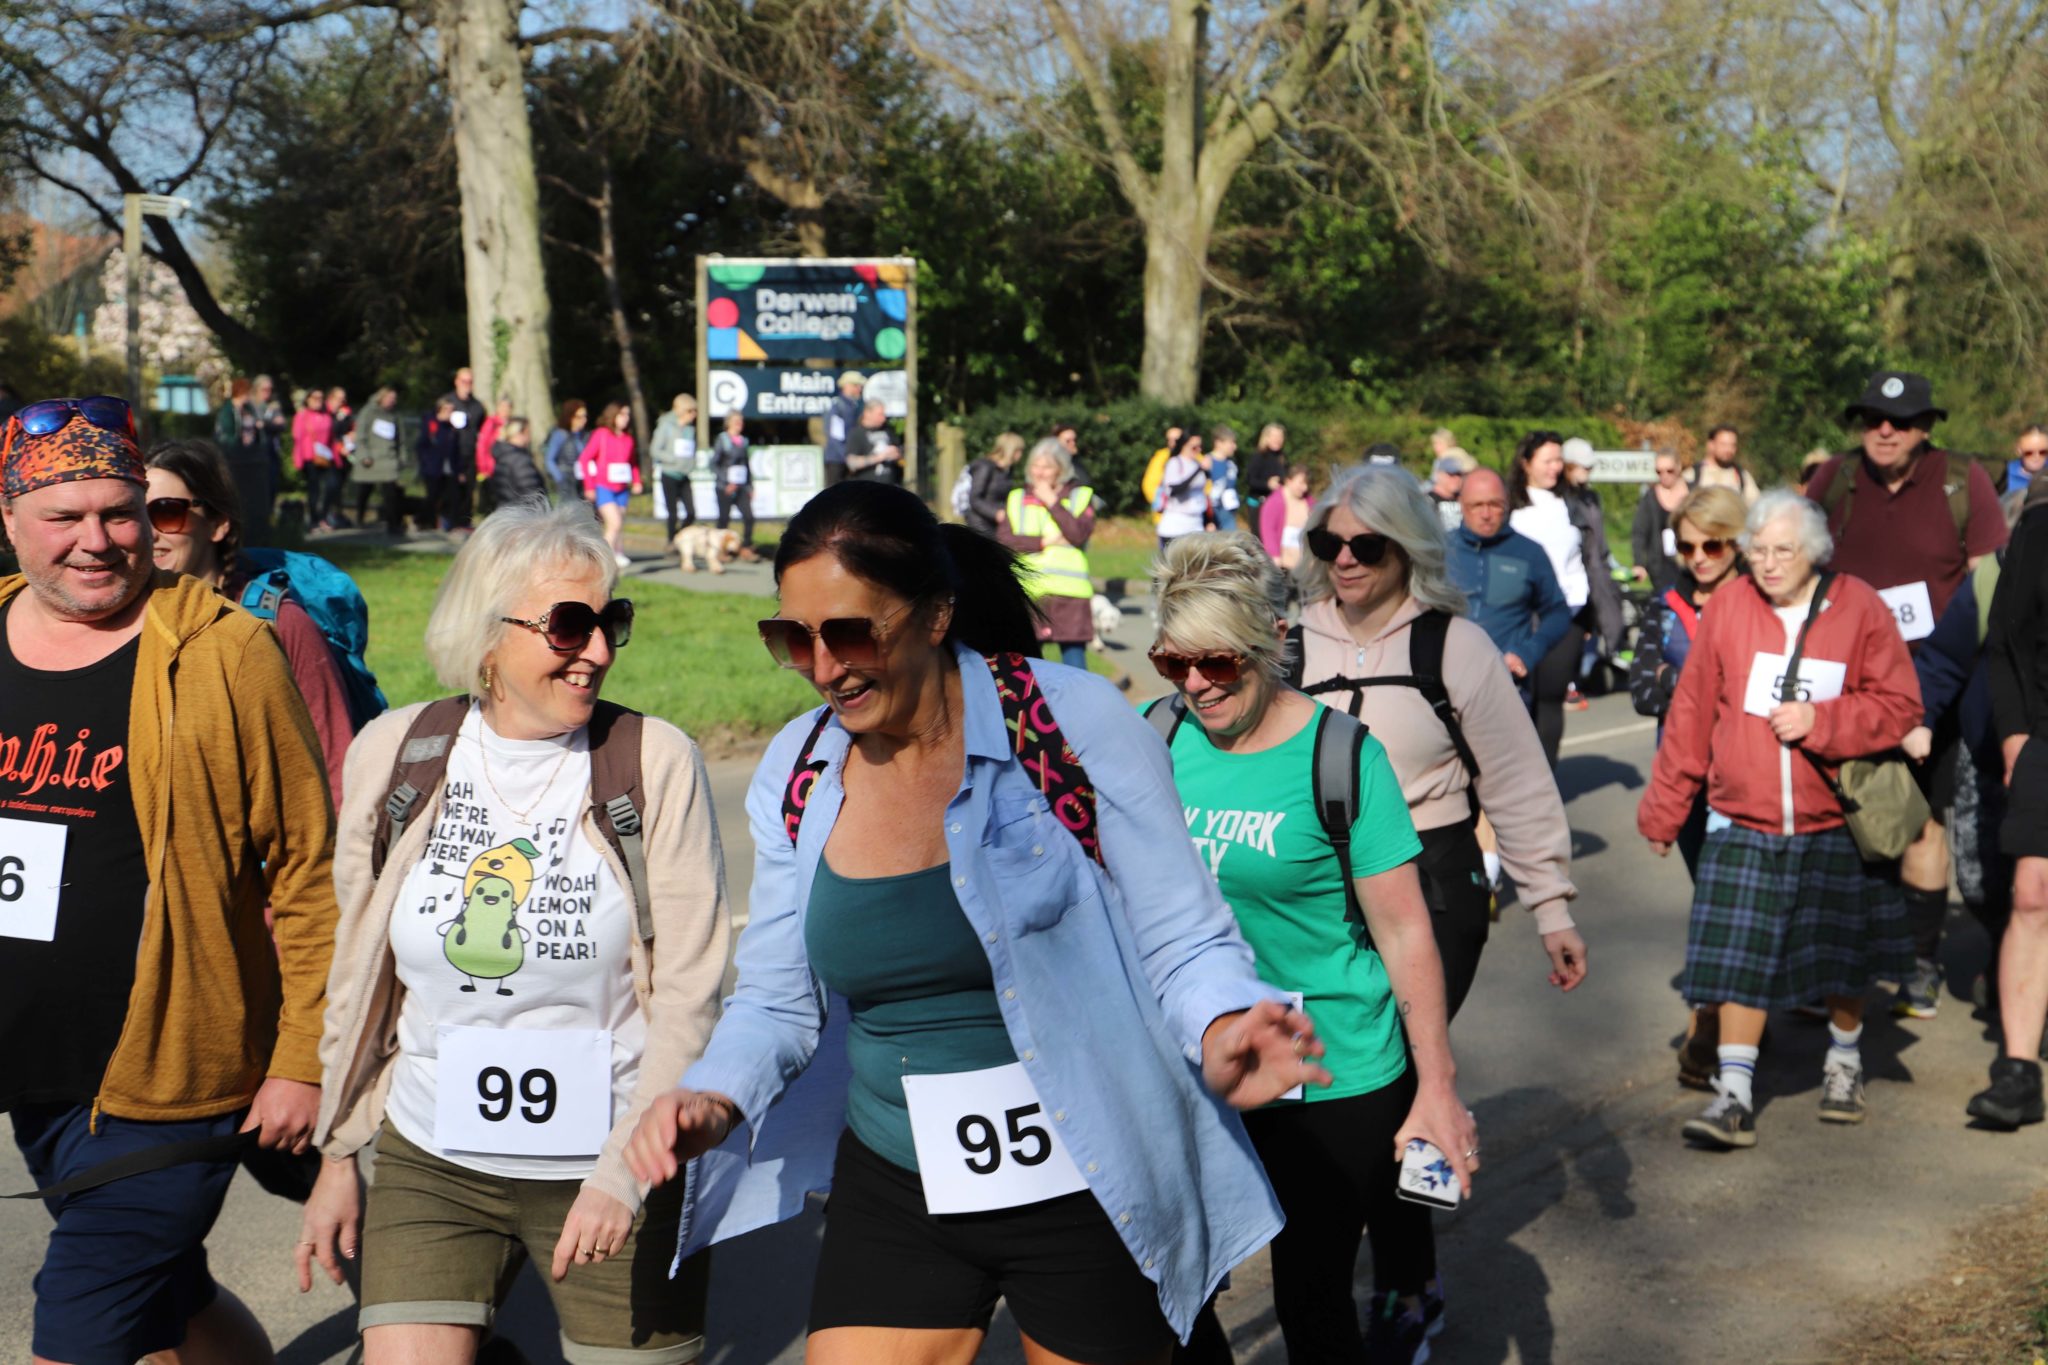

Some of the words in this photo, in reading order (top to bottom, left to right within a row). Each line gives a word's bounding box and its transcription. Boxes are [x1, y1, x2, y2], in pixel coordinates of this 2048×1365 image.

[756, 288, 857, 312] Derwen
[756, 312, 855, 340] College
[715, 380, 736, 404] C
[780, 371, 835, 394] Main
[461, 825, 496, 847] WAY
[1204, 810, 1286, 858] YORK
[544, 874, 596, 892] WOAH
[528, 896, 591, 914] LEMON
[537, 919, 566, 937] ON
[574, 919, 586, 937] A
[536, 941, 597, 960] PEAR!
[477, 1066, 557, 1124] 99
[956, 1102, 1052, 1174] 95
